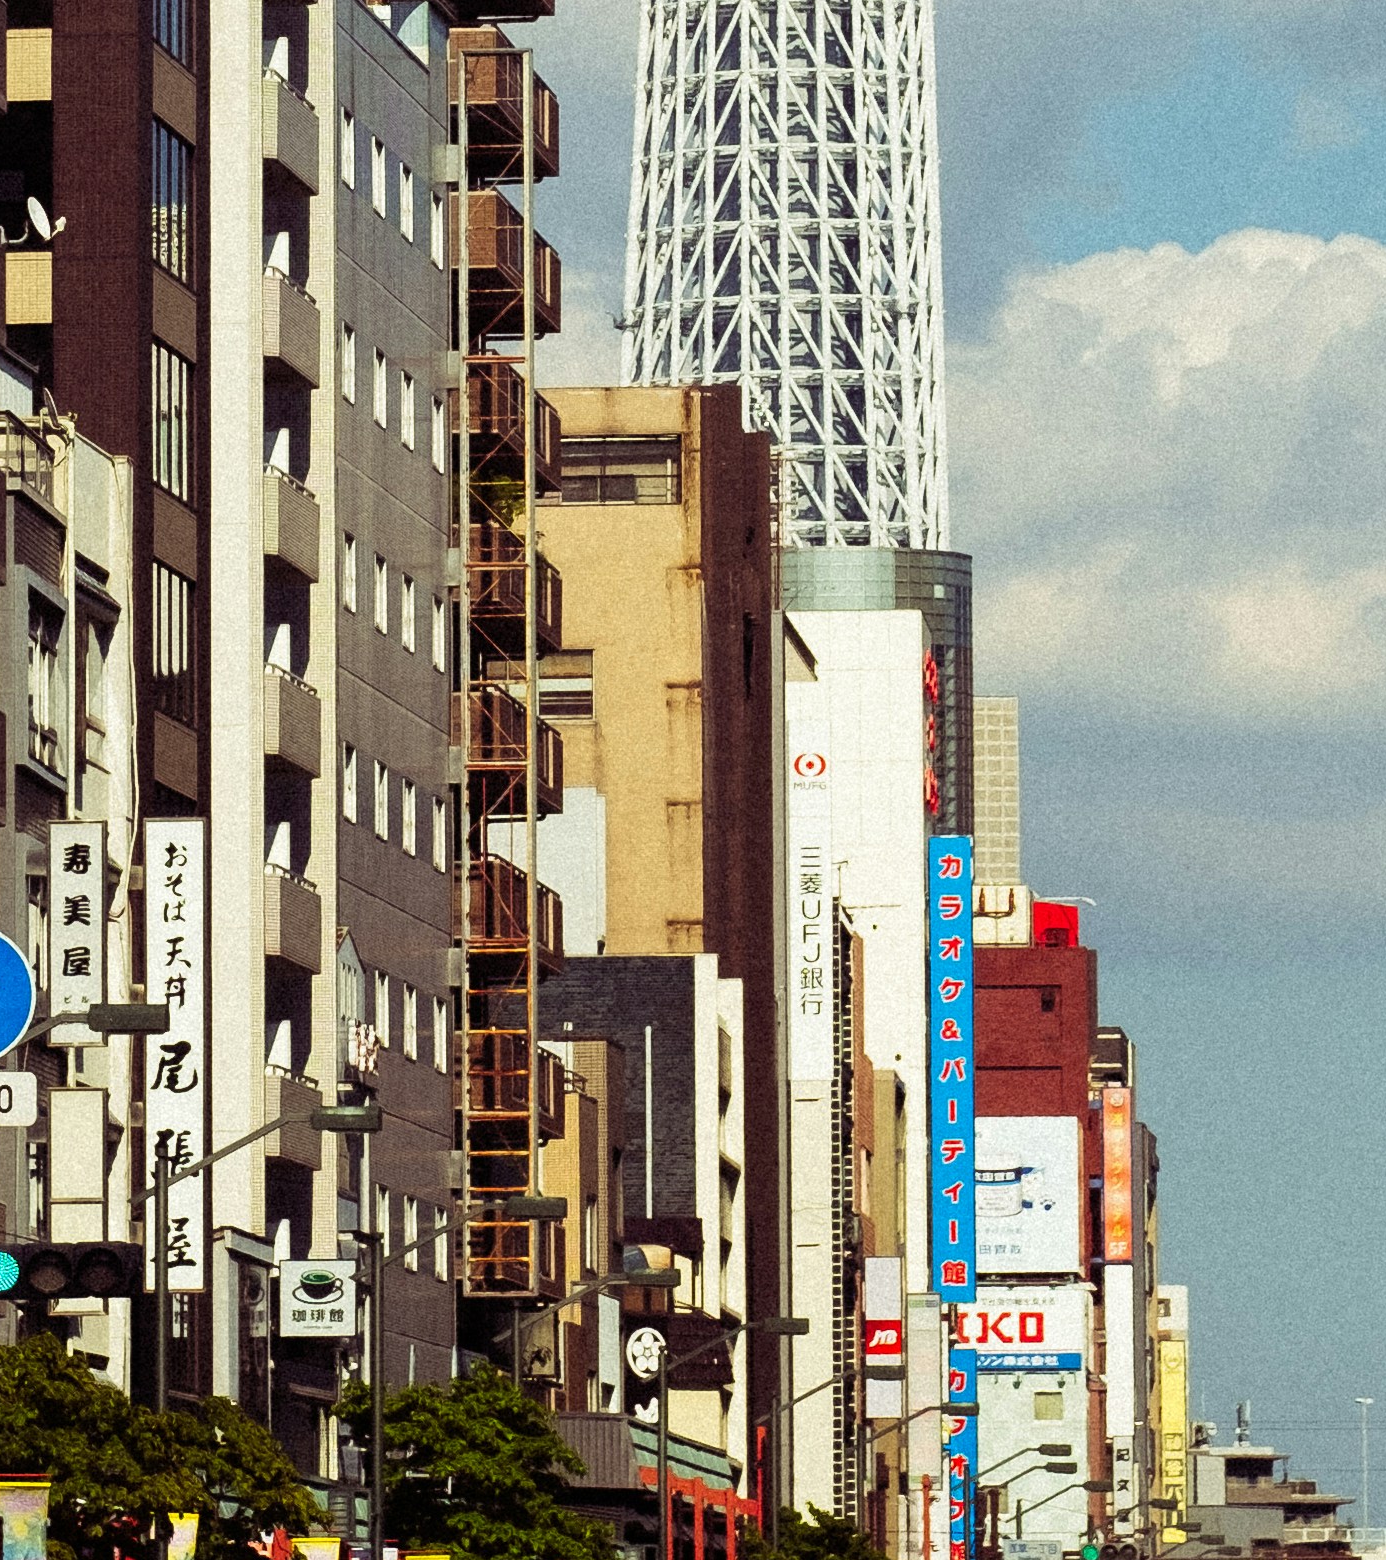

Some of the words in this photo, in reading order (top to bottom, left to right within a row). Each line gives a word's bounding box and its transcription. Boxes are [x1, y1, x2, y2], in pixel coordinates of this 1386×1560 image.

[800, 846, 824, 1015] 三菱UFJ銀行
[869, 1329, 898, 1347] JTB
